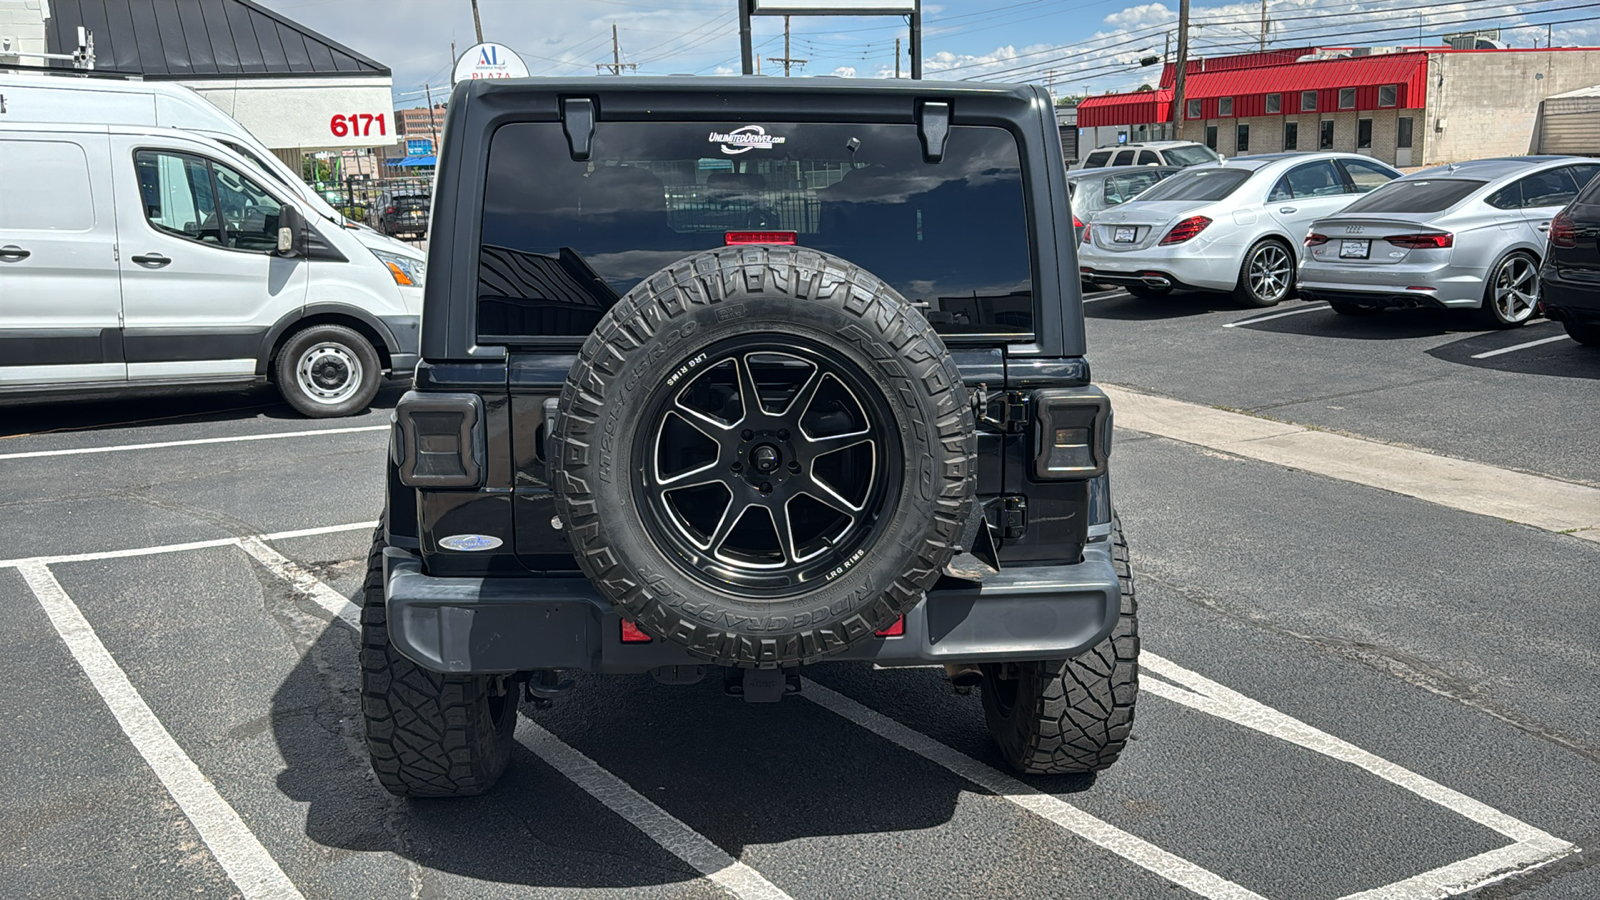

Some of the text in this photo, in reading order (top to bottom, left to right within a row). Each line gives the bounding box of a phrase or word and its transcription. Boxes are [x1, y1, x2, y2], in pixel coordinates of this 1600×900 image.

[476, 46, 506, 66] AL
[330, 113, 386, 137] 6171
[666, 352, 708, 386] LRG RIMS
[836, 324, 934, 501] NITTO
[825, 566, 844, 581] LRG
[843, 549, 865, 568] RIMS
[638, 564, 875, 632] RIDGE GRAPPLER
